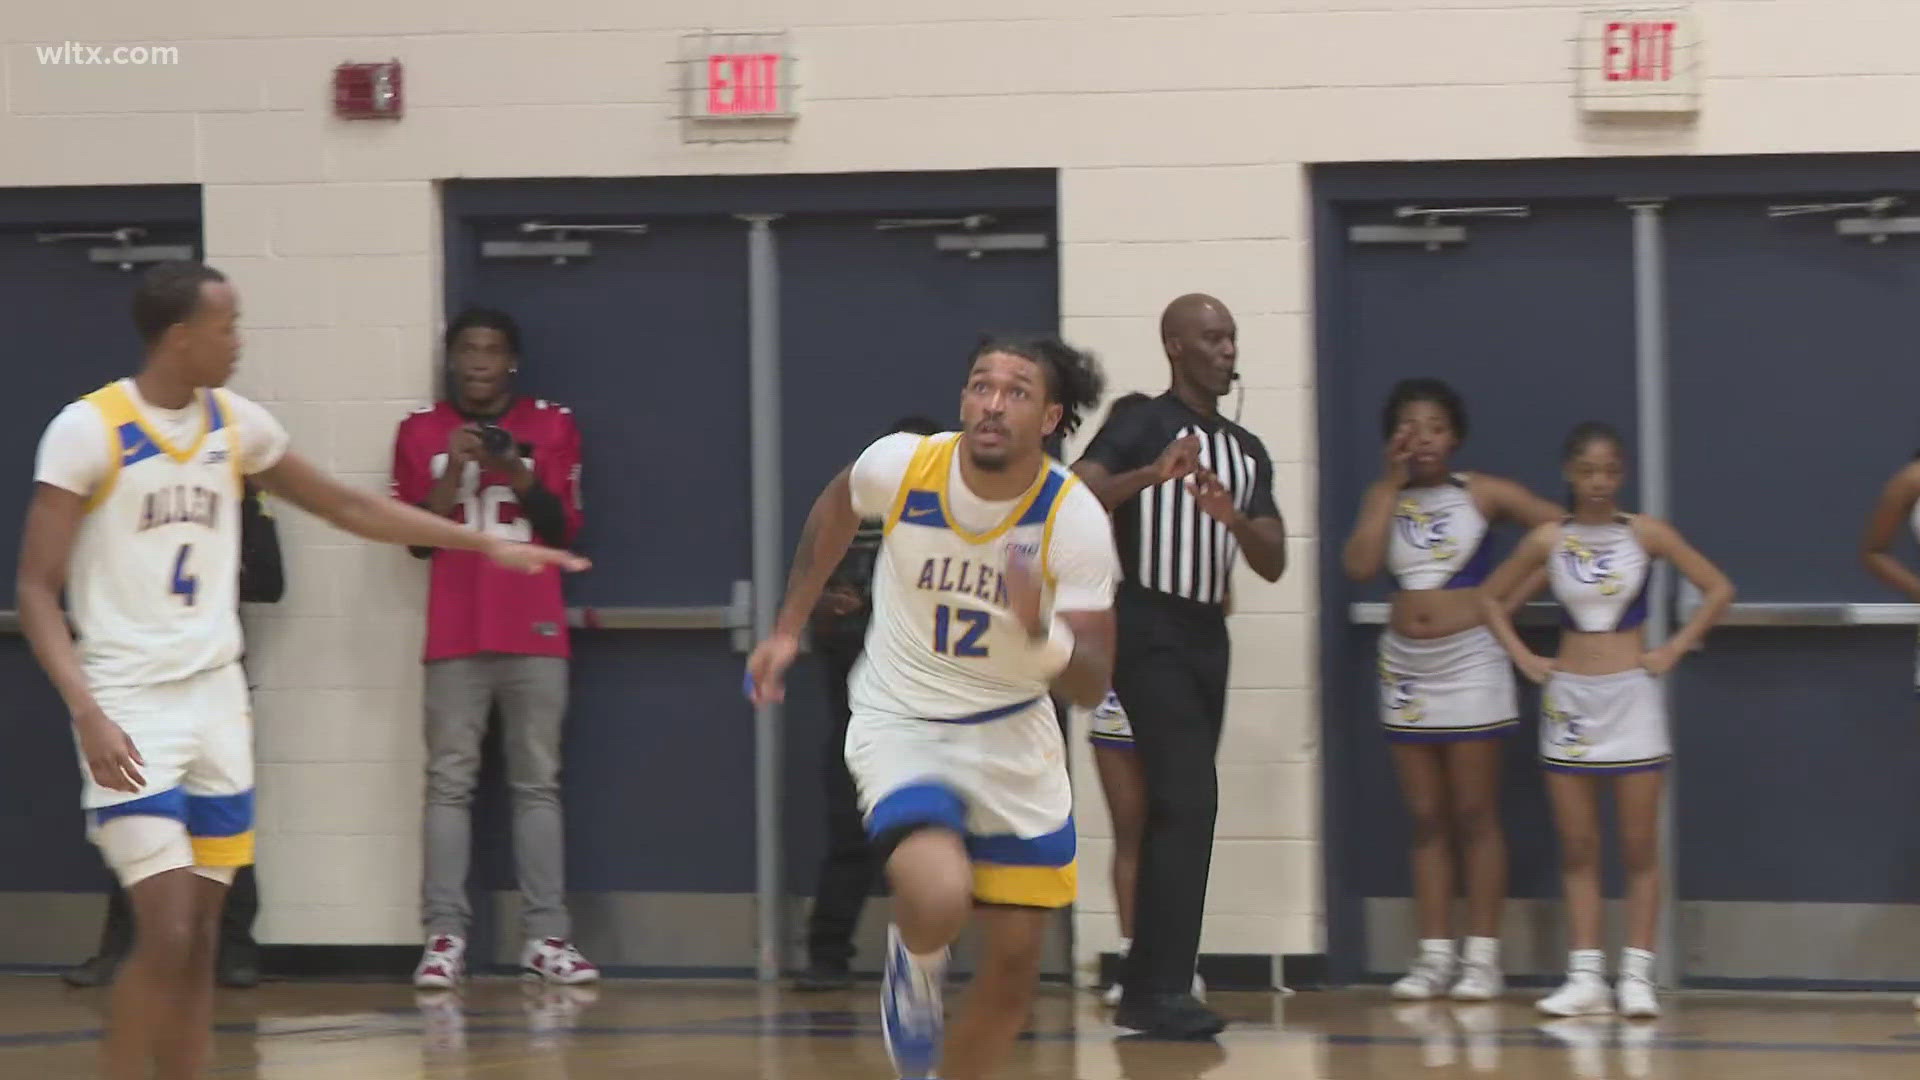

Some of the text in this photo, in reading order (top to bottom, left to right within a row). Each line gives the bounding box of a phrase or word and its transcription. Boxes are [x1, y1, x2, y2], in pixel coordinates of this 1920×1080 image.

[1603, 22, 1676, 81] EXIT
[707, 54, 781, 114] EXIT
[171, 543, 197, 606] 4
[934, 603, 991, 657] 12
